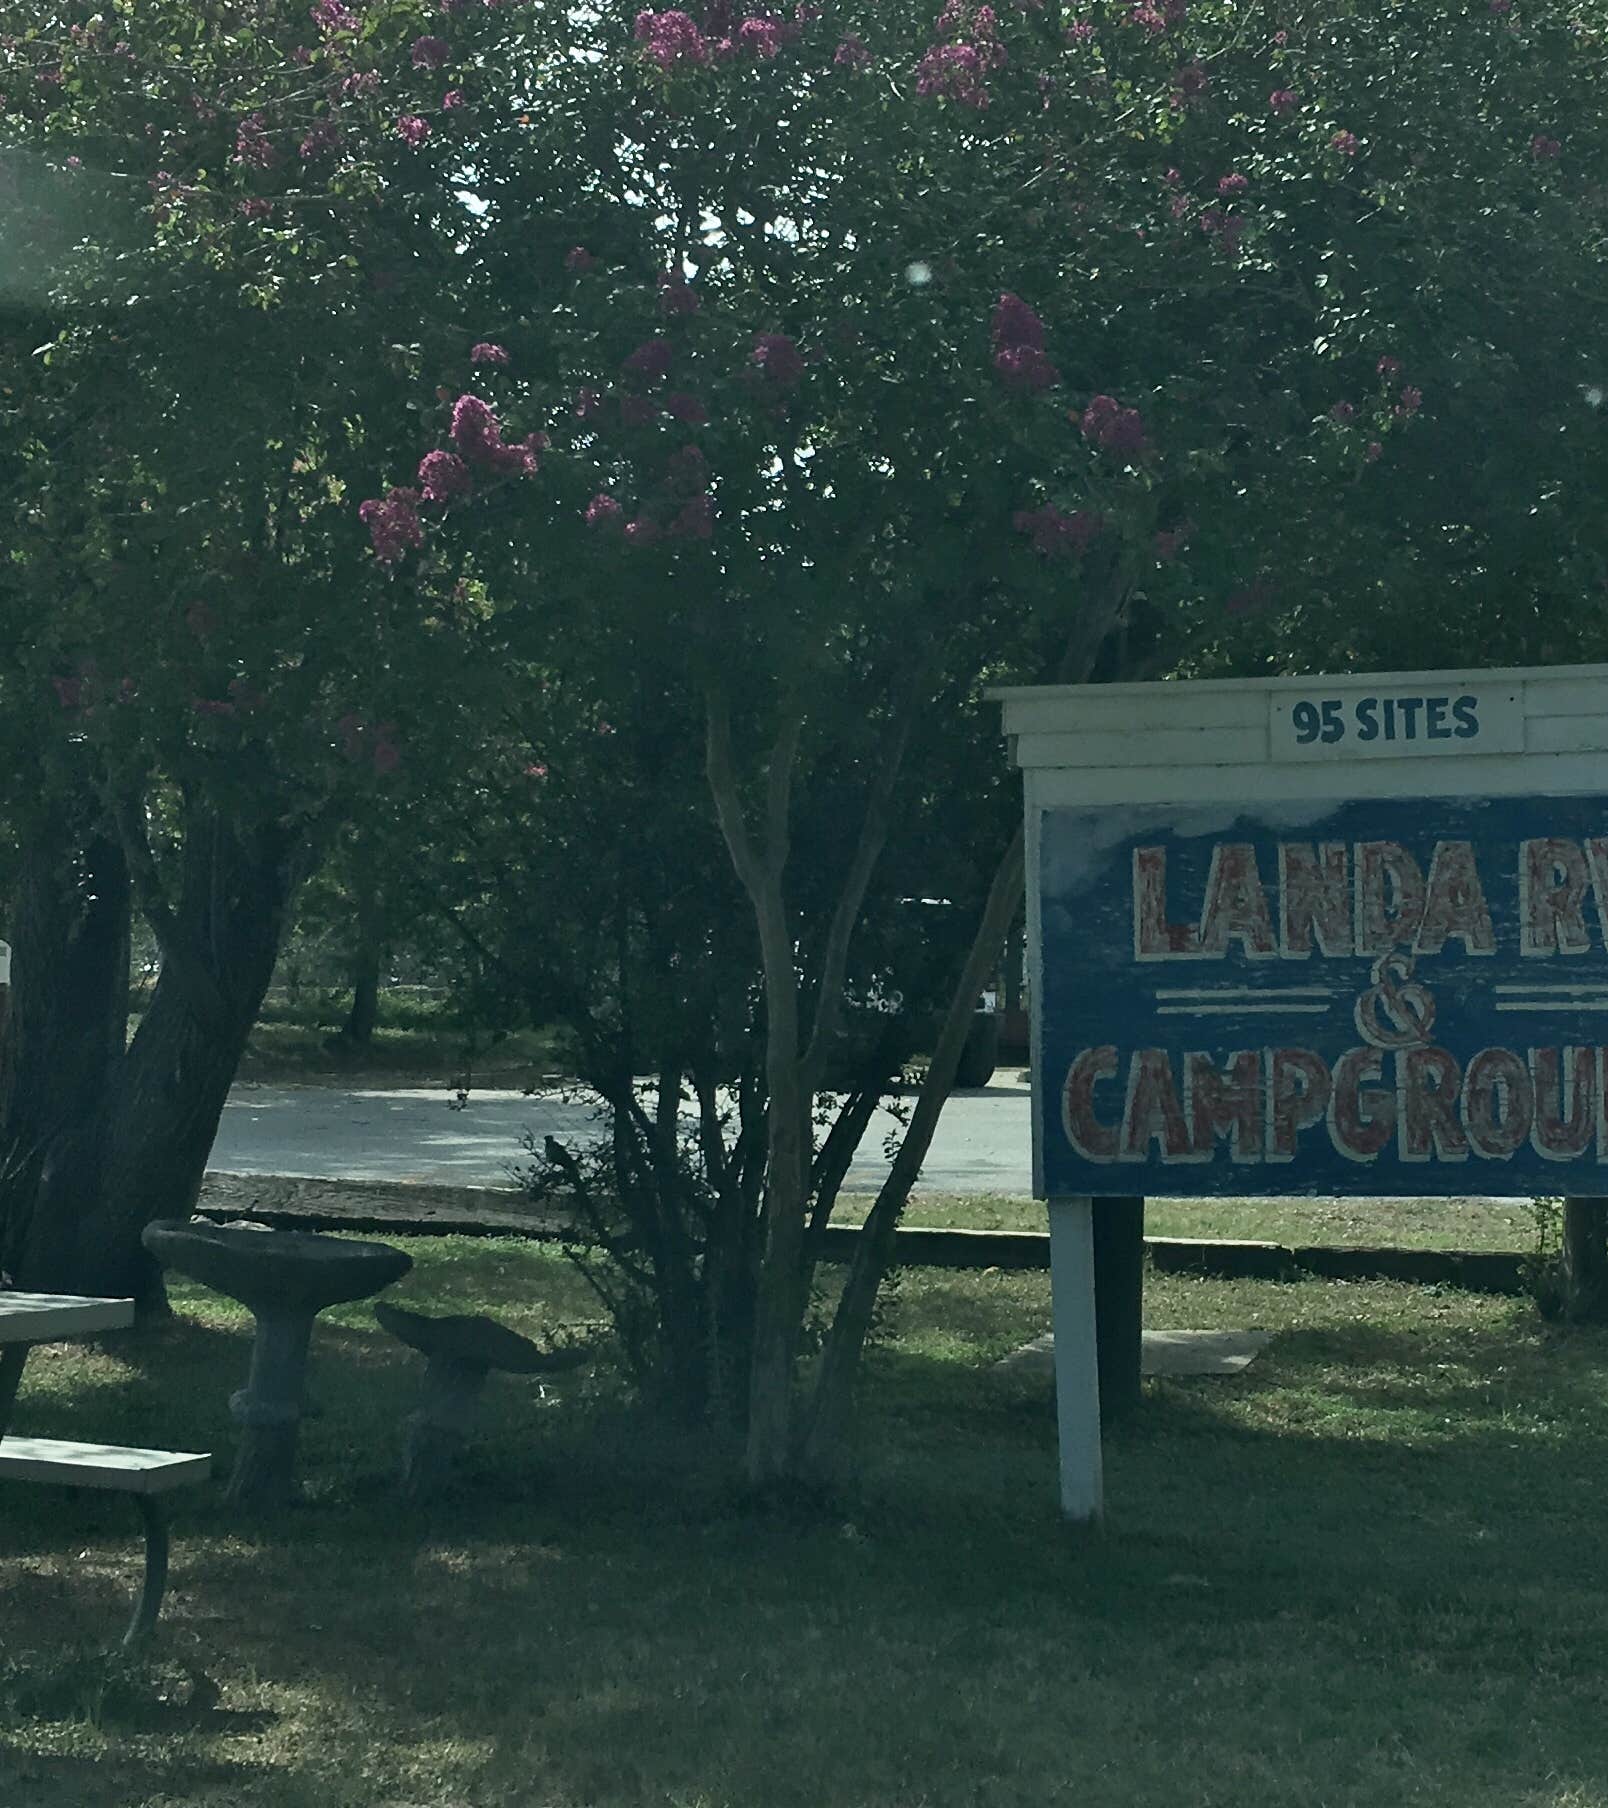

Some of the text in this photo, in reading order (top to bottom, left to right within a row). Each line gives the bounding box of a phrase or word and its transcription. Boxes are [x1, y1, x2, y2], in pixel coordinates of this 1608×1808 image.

[1292, 696, 1480, 744] 95 SITES
[1133, 838, 1498, 962] LANDA
[1354, 948, 1436, 1049] &
